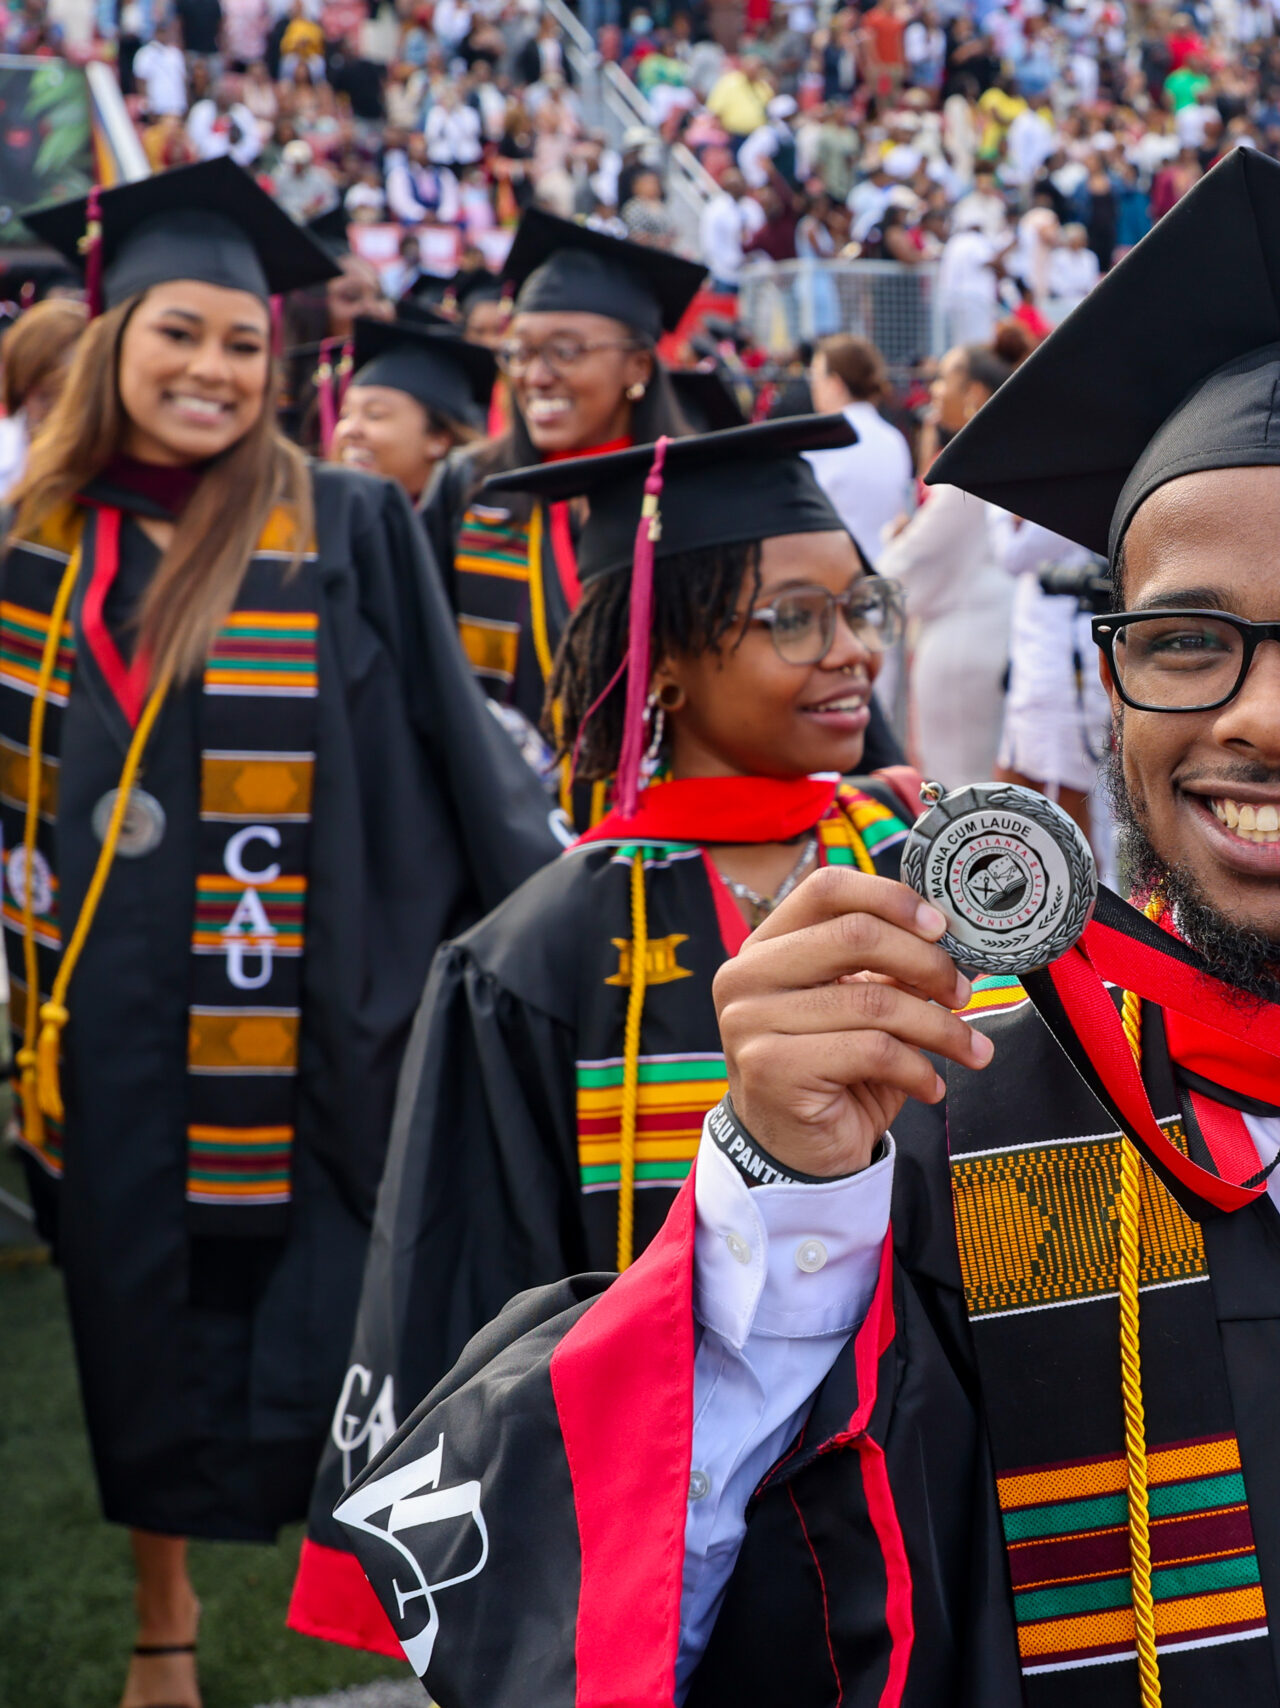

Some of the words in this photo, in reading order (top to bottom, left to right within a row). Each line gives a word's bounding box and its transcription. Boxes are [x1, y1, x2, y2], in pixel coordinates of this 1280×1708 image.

[933, 847, 951, 899] MAGNA
[949, 821, 978, 845] CUM
[981, 817, 1032, 838] LAUDE
[969, 838, 1028, 858] ATLANTA
[221, 825, 281, 989] CAU
[952, 859, 964, 903] CLARK
[976, 874, 1043, 926] UNIVERSITY
[710, 1105, 735, 1142] CAU
[727, 1134, 806, 1184] PANTH
